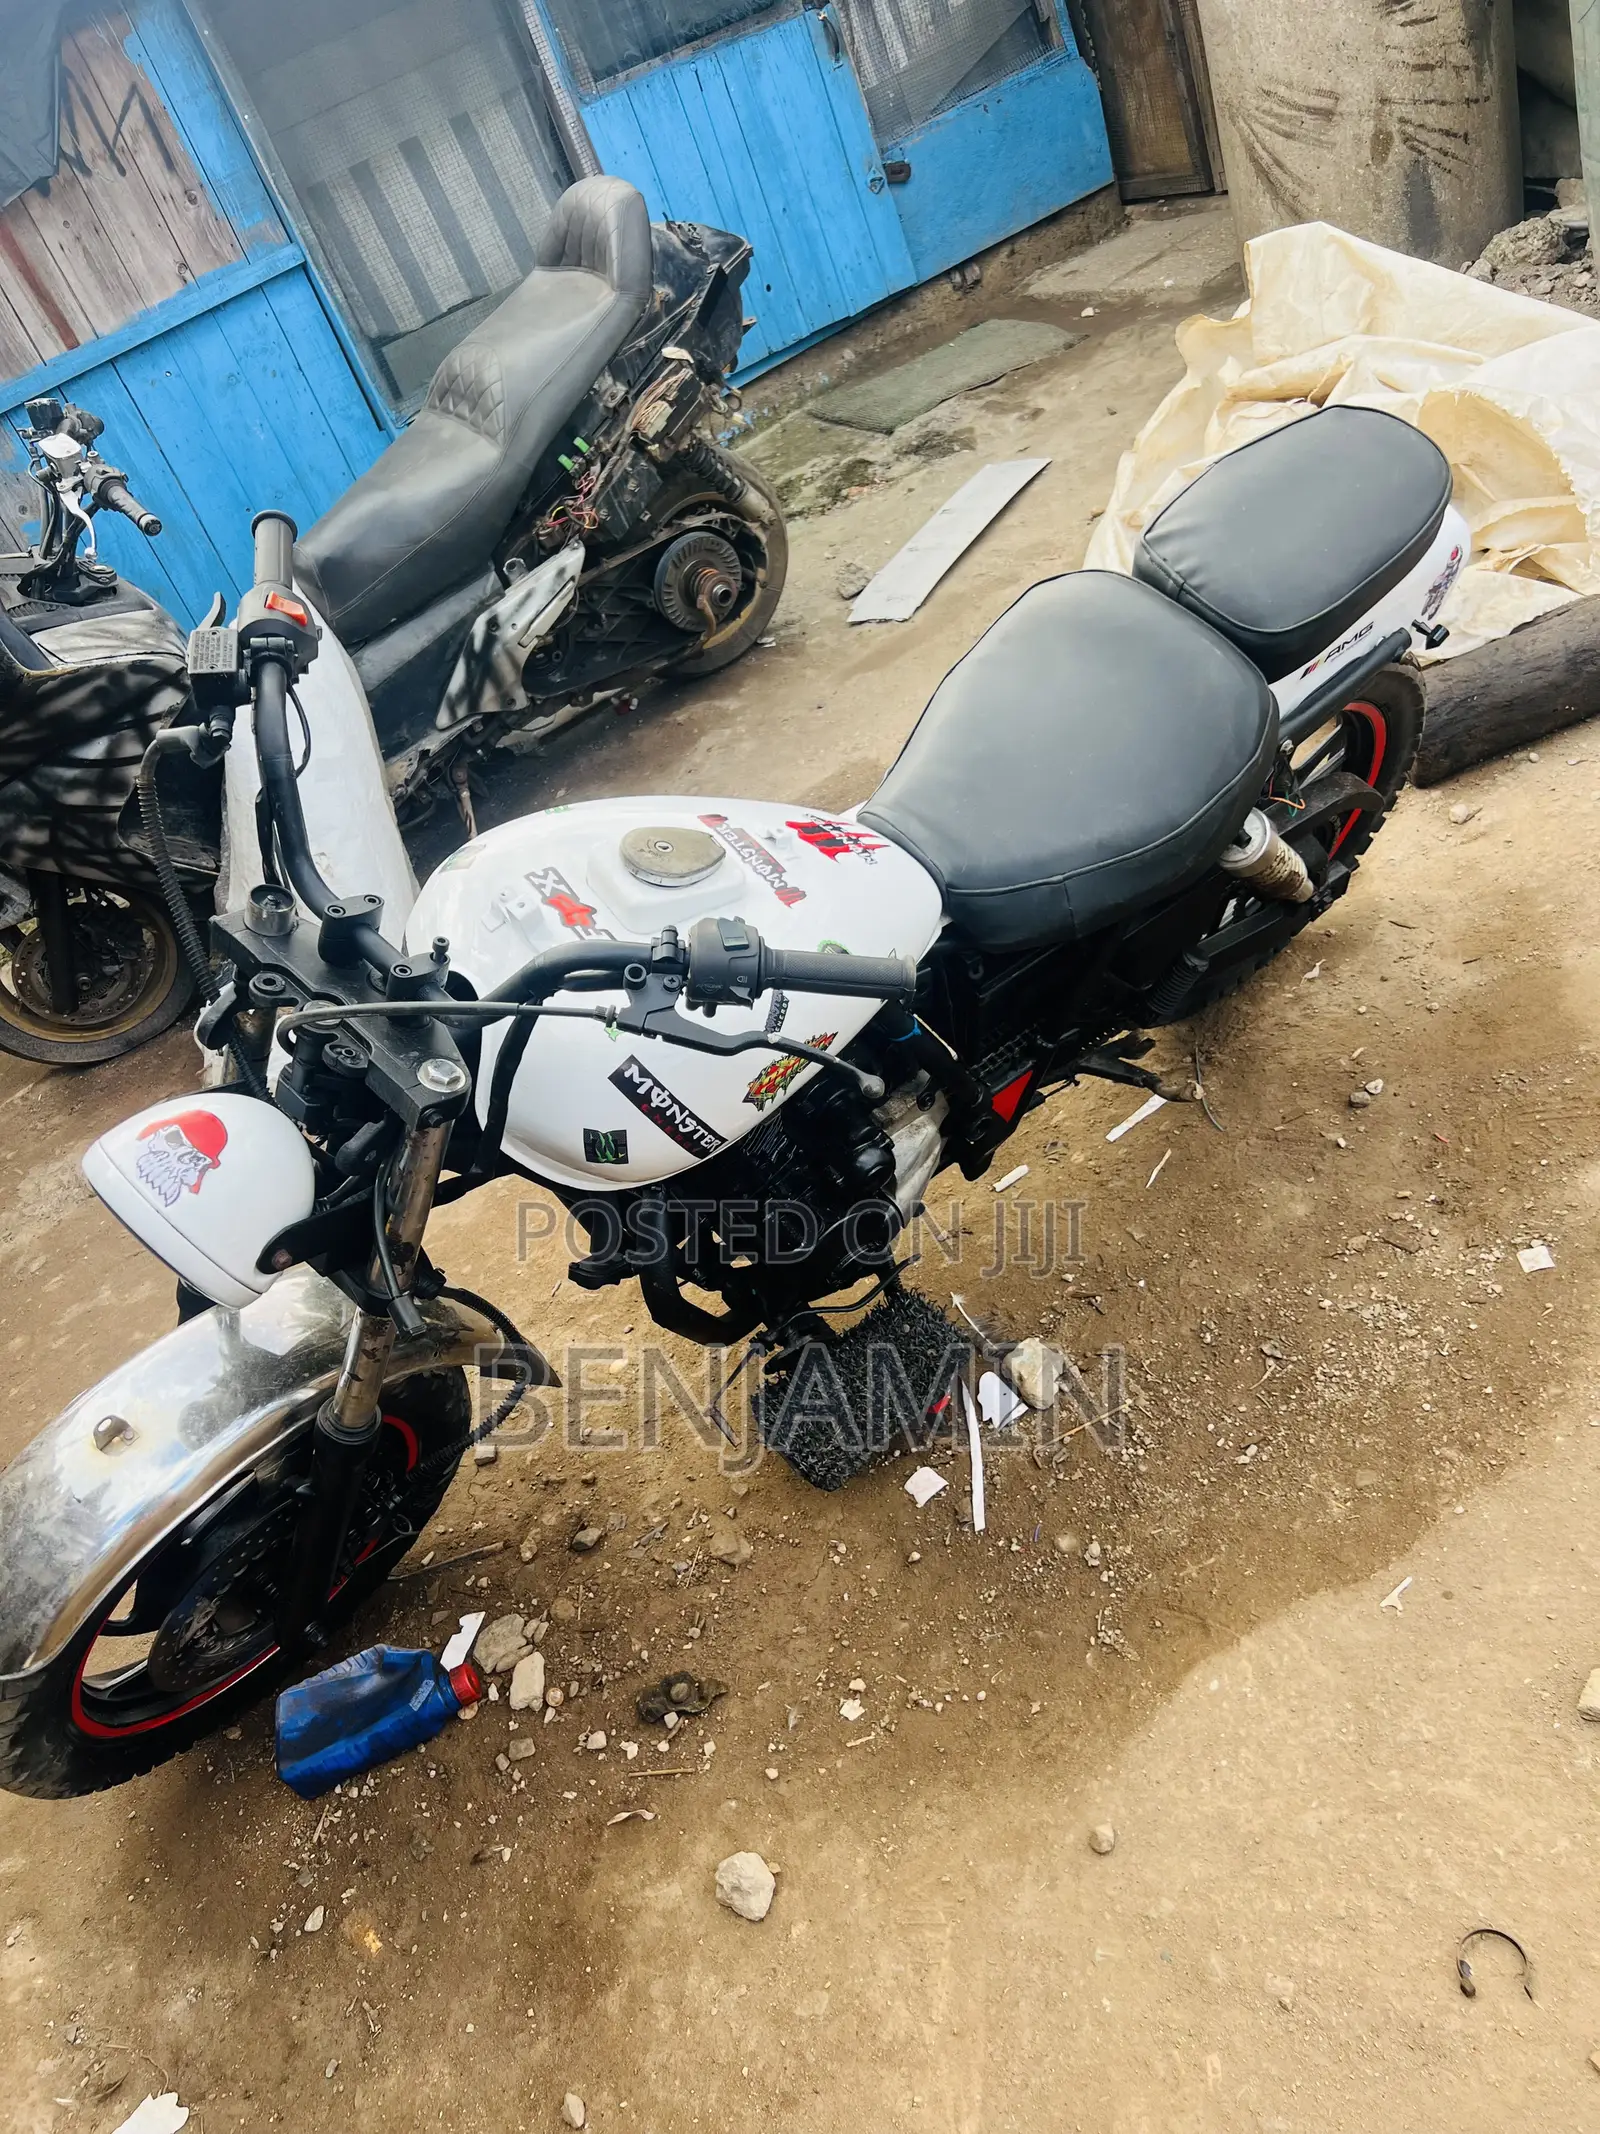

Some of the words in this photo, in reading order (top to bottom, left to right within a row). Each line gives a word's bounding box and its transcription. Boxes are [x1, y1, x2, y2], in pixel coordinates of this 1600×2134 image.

[1324, 621, 1374, 663] AMG
[715, 823, 785, 889] MONSTER
[624, 1063, 721, 1152] MONSTER
